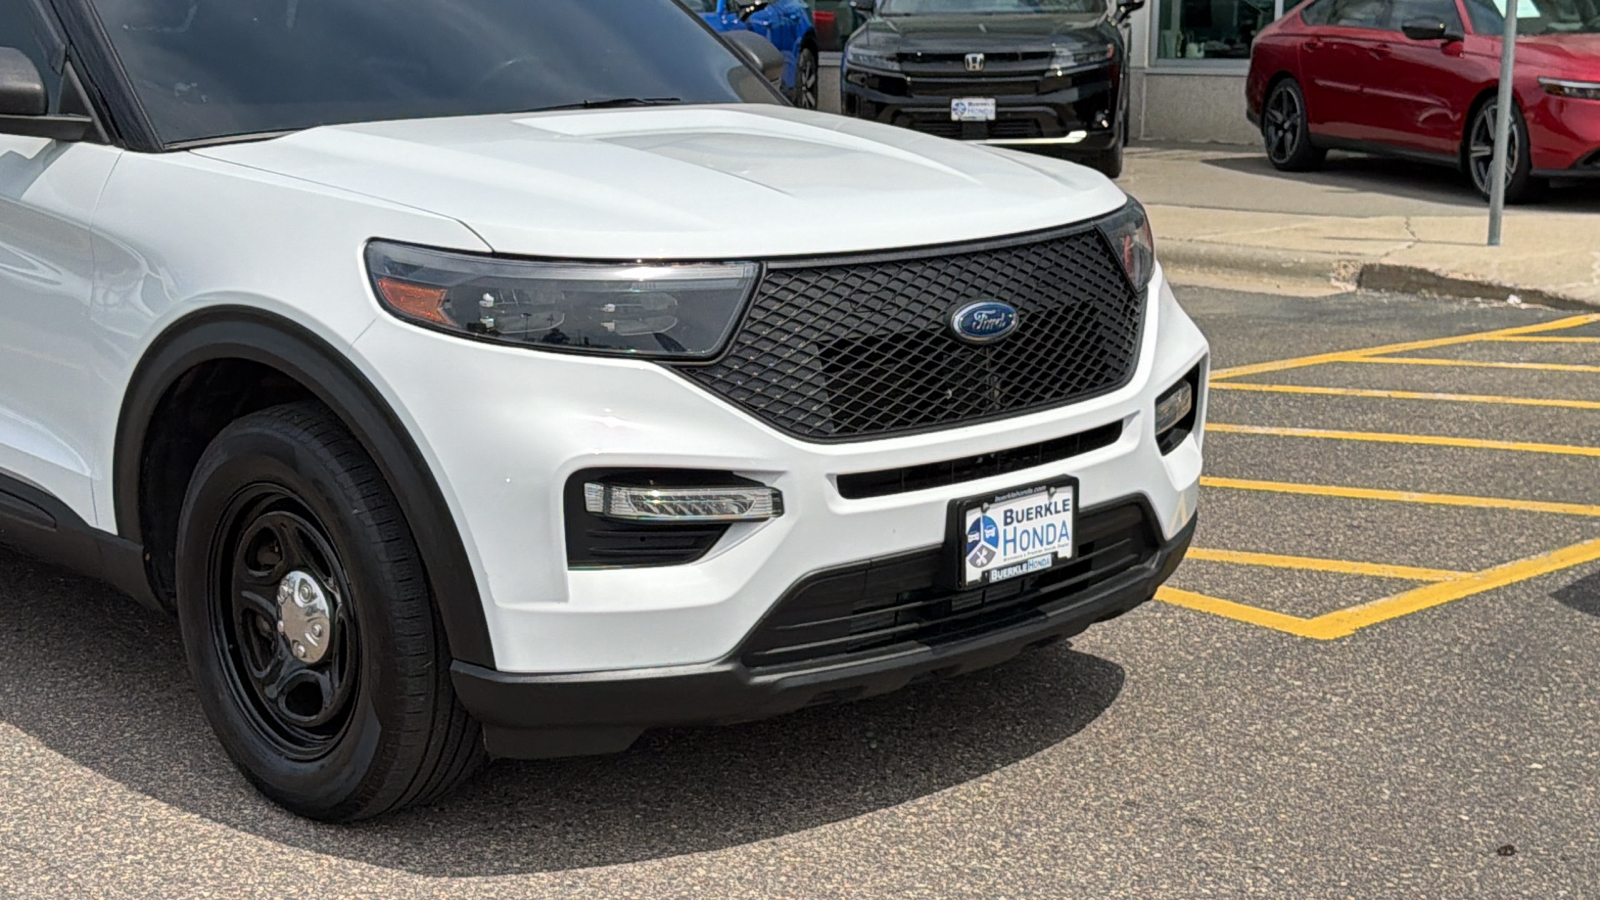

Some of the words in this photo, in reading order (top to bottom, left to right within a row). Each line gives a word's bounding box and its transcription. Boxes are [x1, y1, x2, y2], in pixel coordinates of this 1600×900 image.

[972, 309, 1006, 330] Ford
[1003, 498, 1071, 527] BUERKLE
[1003, 519, 1070, 557] HONDA
[991, 563, 1027, 581] BUERKLE
[1028, 557, 1050, 570] HONDA
